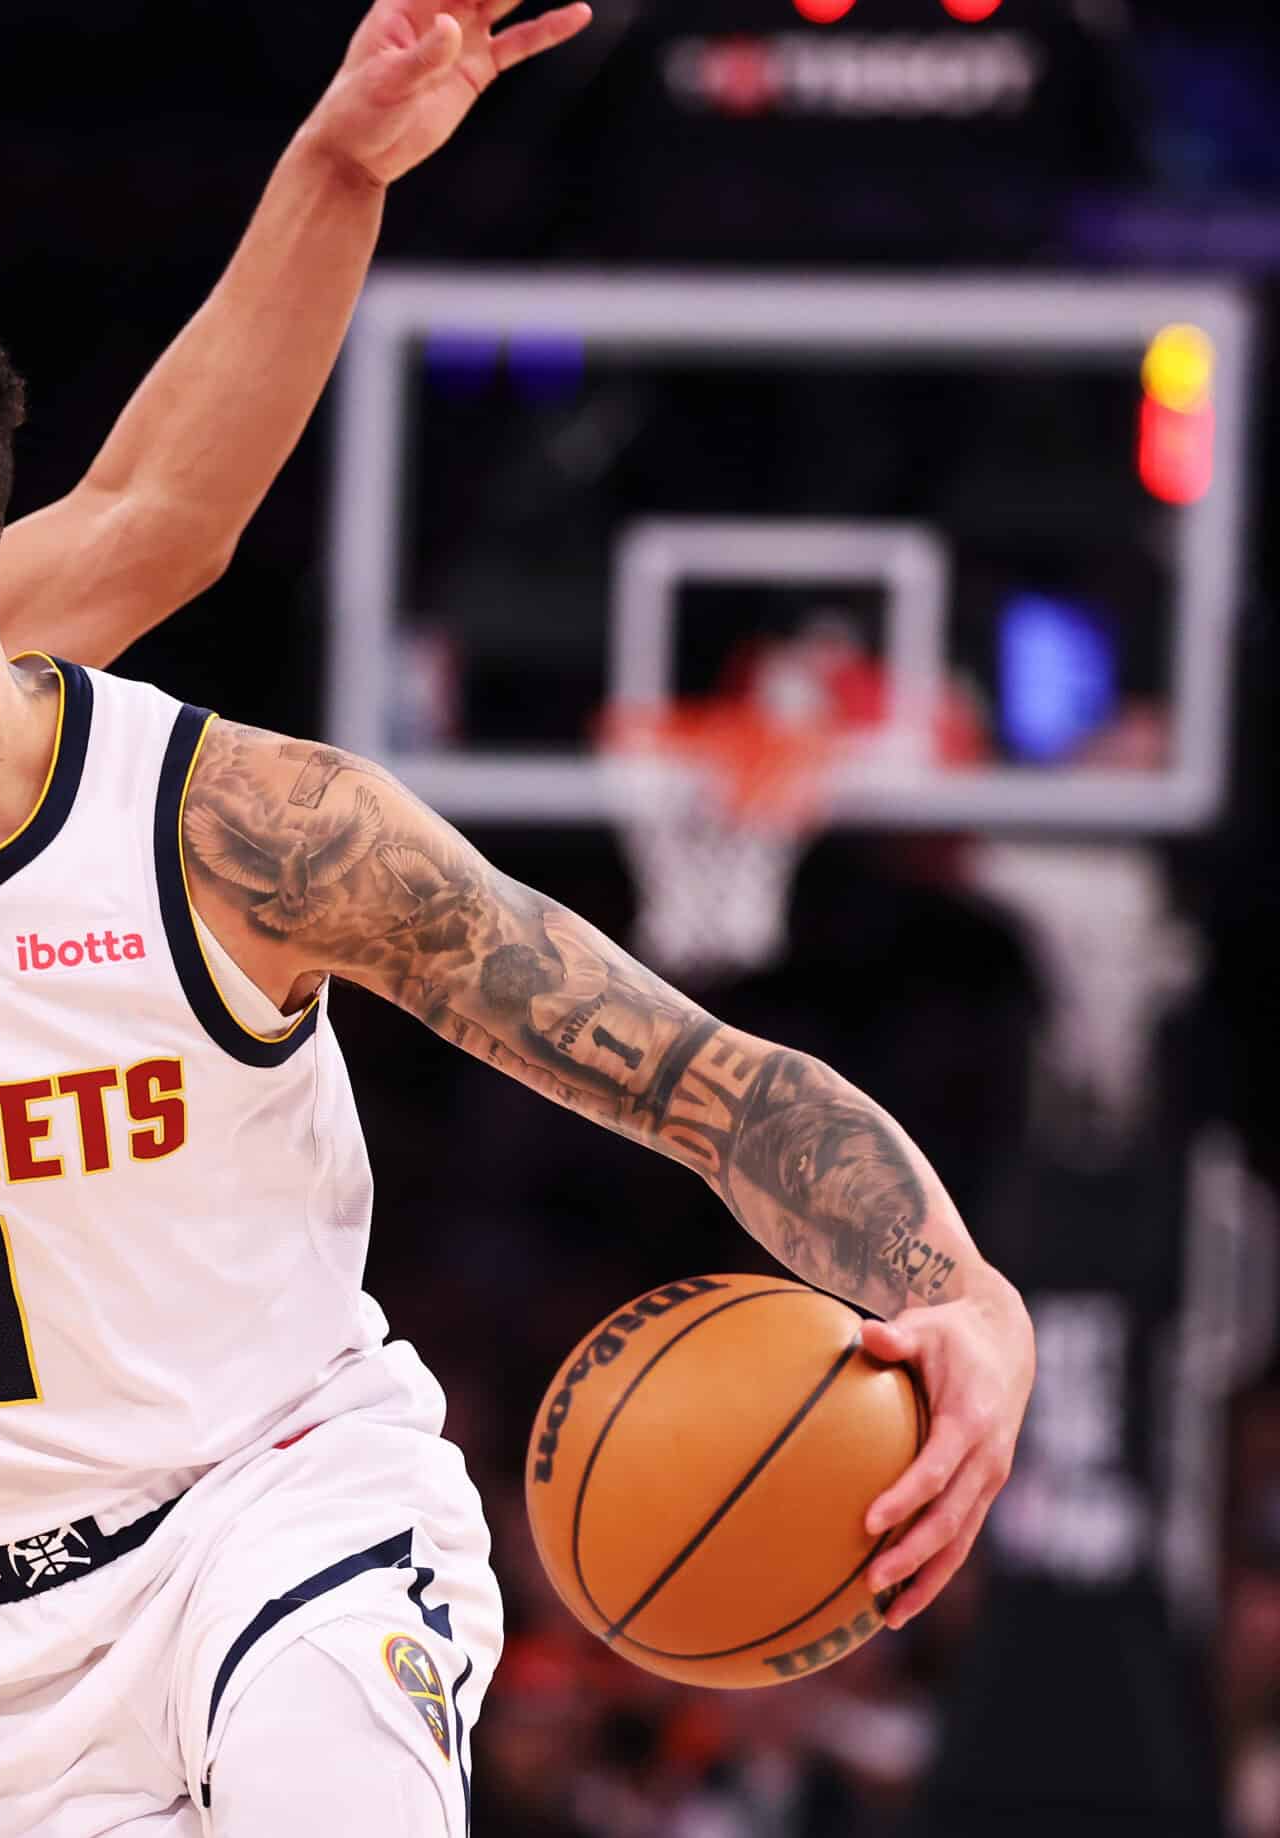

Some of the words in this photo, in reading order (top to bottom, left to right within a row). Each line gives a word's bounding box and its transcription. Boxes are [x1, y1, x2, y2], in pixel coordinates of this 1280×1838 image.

[16, 929, 146, 972] ibotta
[592, 1024, 644, 1070] 1
[534, 1278, 732, 1484] Wilson
